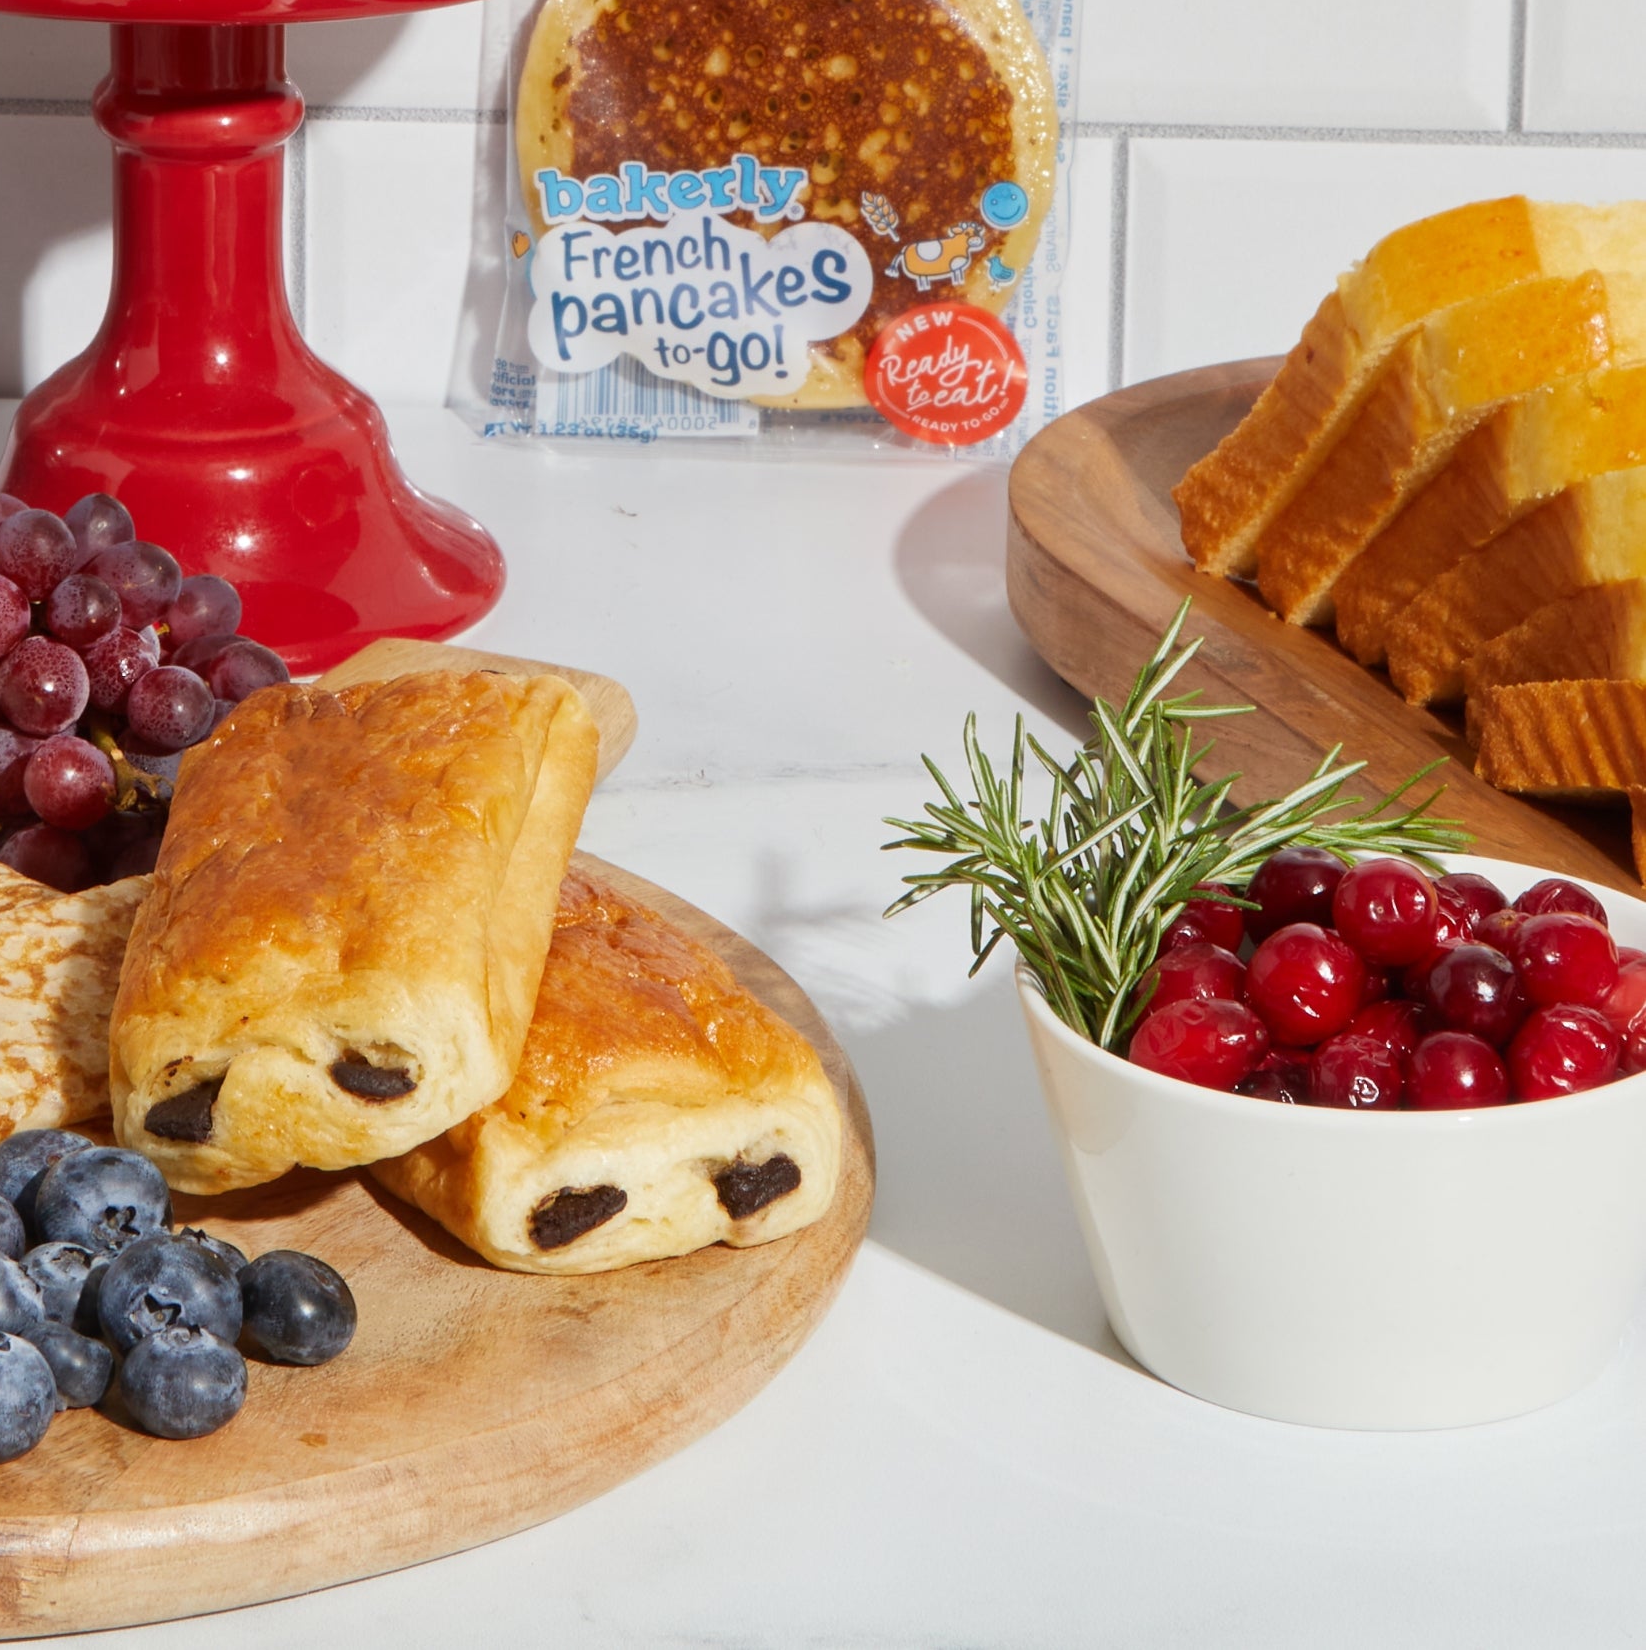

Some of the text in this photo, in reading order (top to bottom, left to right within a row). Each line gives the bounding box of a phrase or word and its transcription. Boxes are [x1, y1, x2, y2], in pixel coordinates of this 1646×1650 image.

[538, 155, 805, 218] bakerly
[560, 216, 731, 282] French
[551, 248, 852, 362] pancakes
[895, 311, 954, 342] NEW
[879, 334, 983, 387] Ready
[906, 359, 1015, 412] to eat!
[540, 421, 579, 437] 1.23
[583, 426, 603, 438] oz
[608, 423, 659, 443] (35g)
[911, 414, 959, 433] READY
